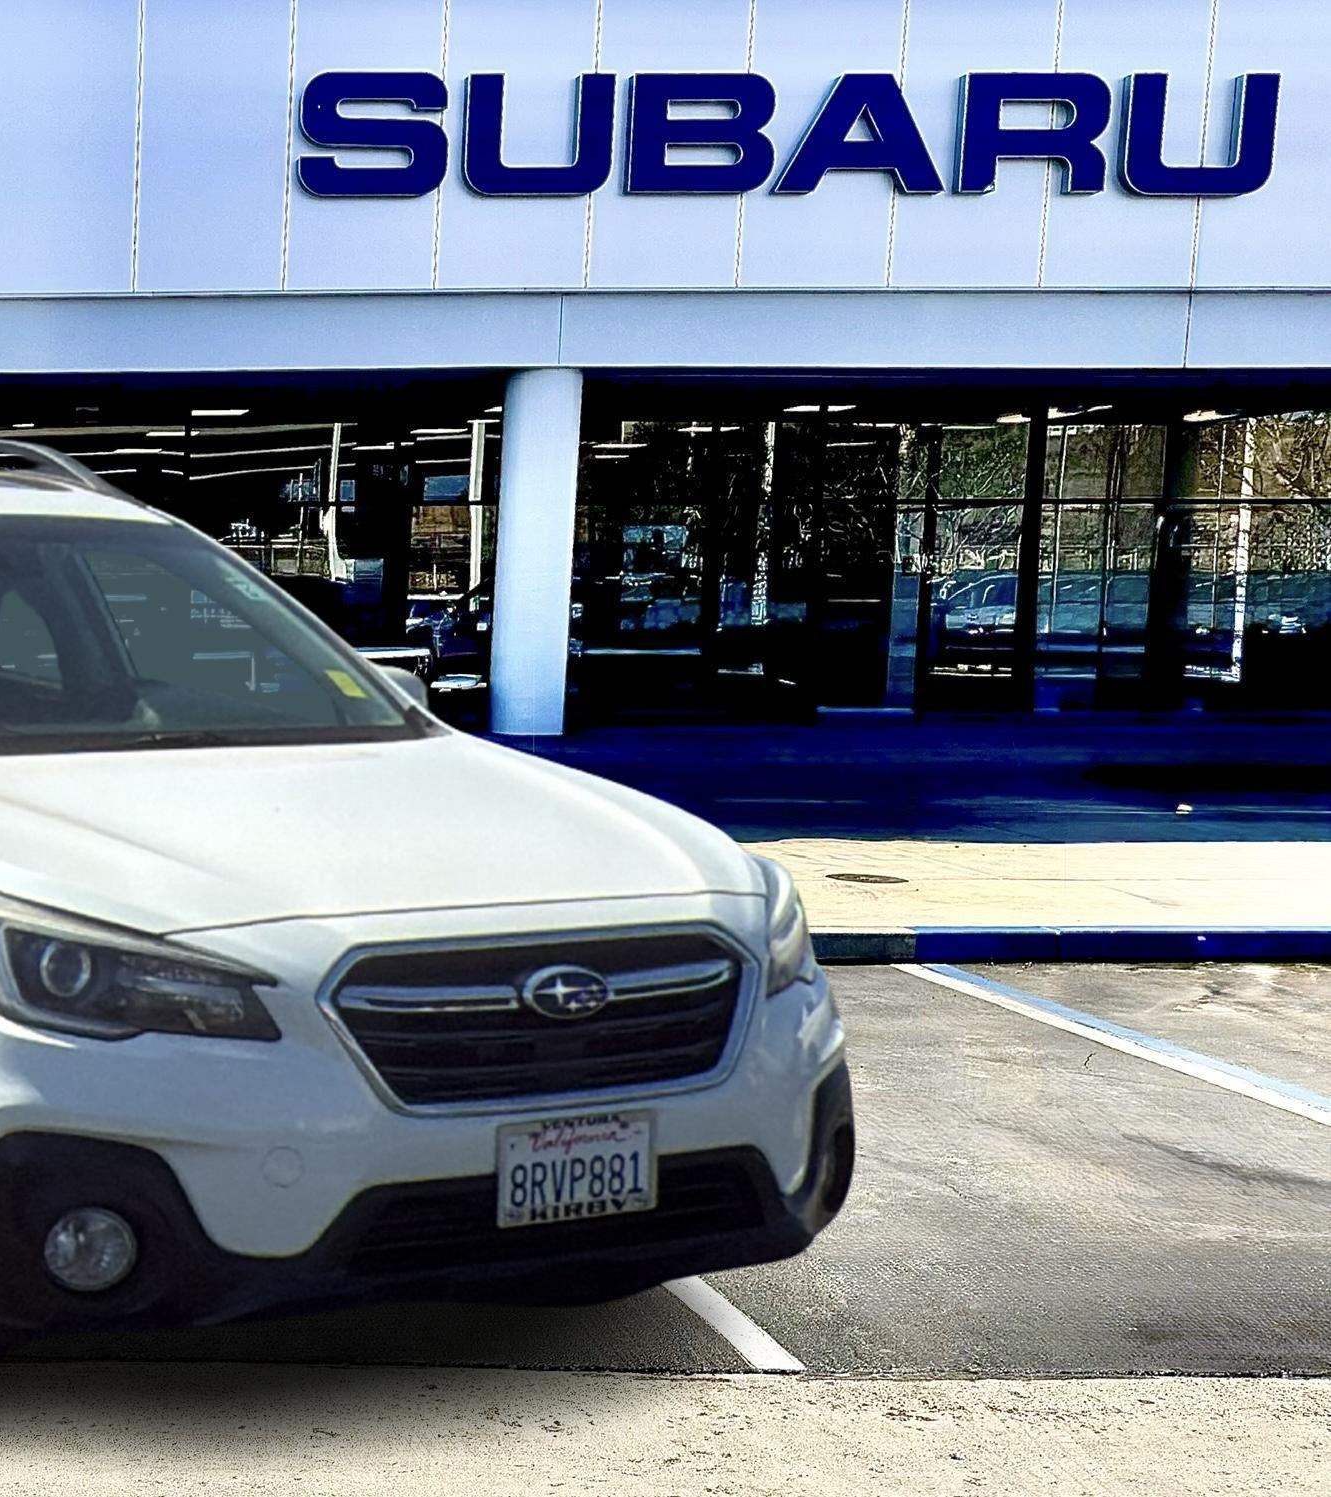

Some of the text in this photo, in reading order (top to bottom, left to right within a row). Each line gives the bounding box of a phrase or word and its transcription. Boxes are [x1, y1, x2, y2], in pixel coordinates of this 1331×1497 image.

[297, 71, 1281, 198] SUBARU
[541, 1114, 621, 1132] VENTURA
[528, 1126, 627, 1155] California
[510, 1150, 644, 1208] 8RVP881
[529, 1197, 629, 1221] KIRBY
